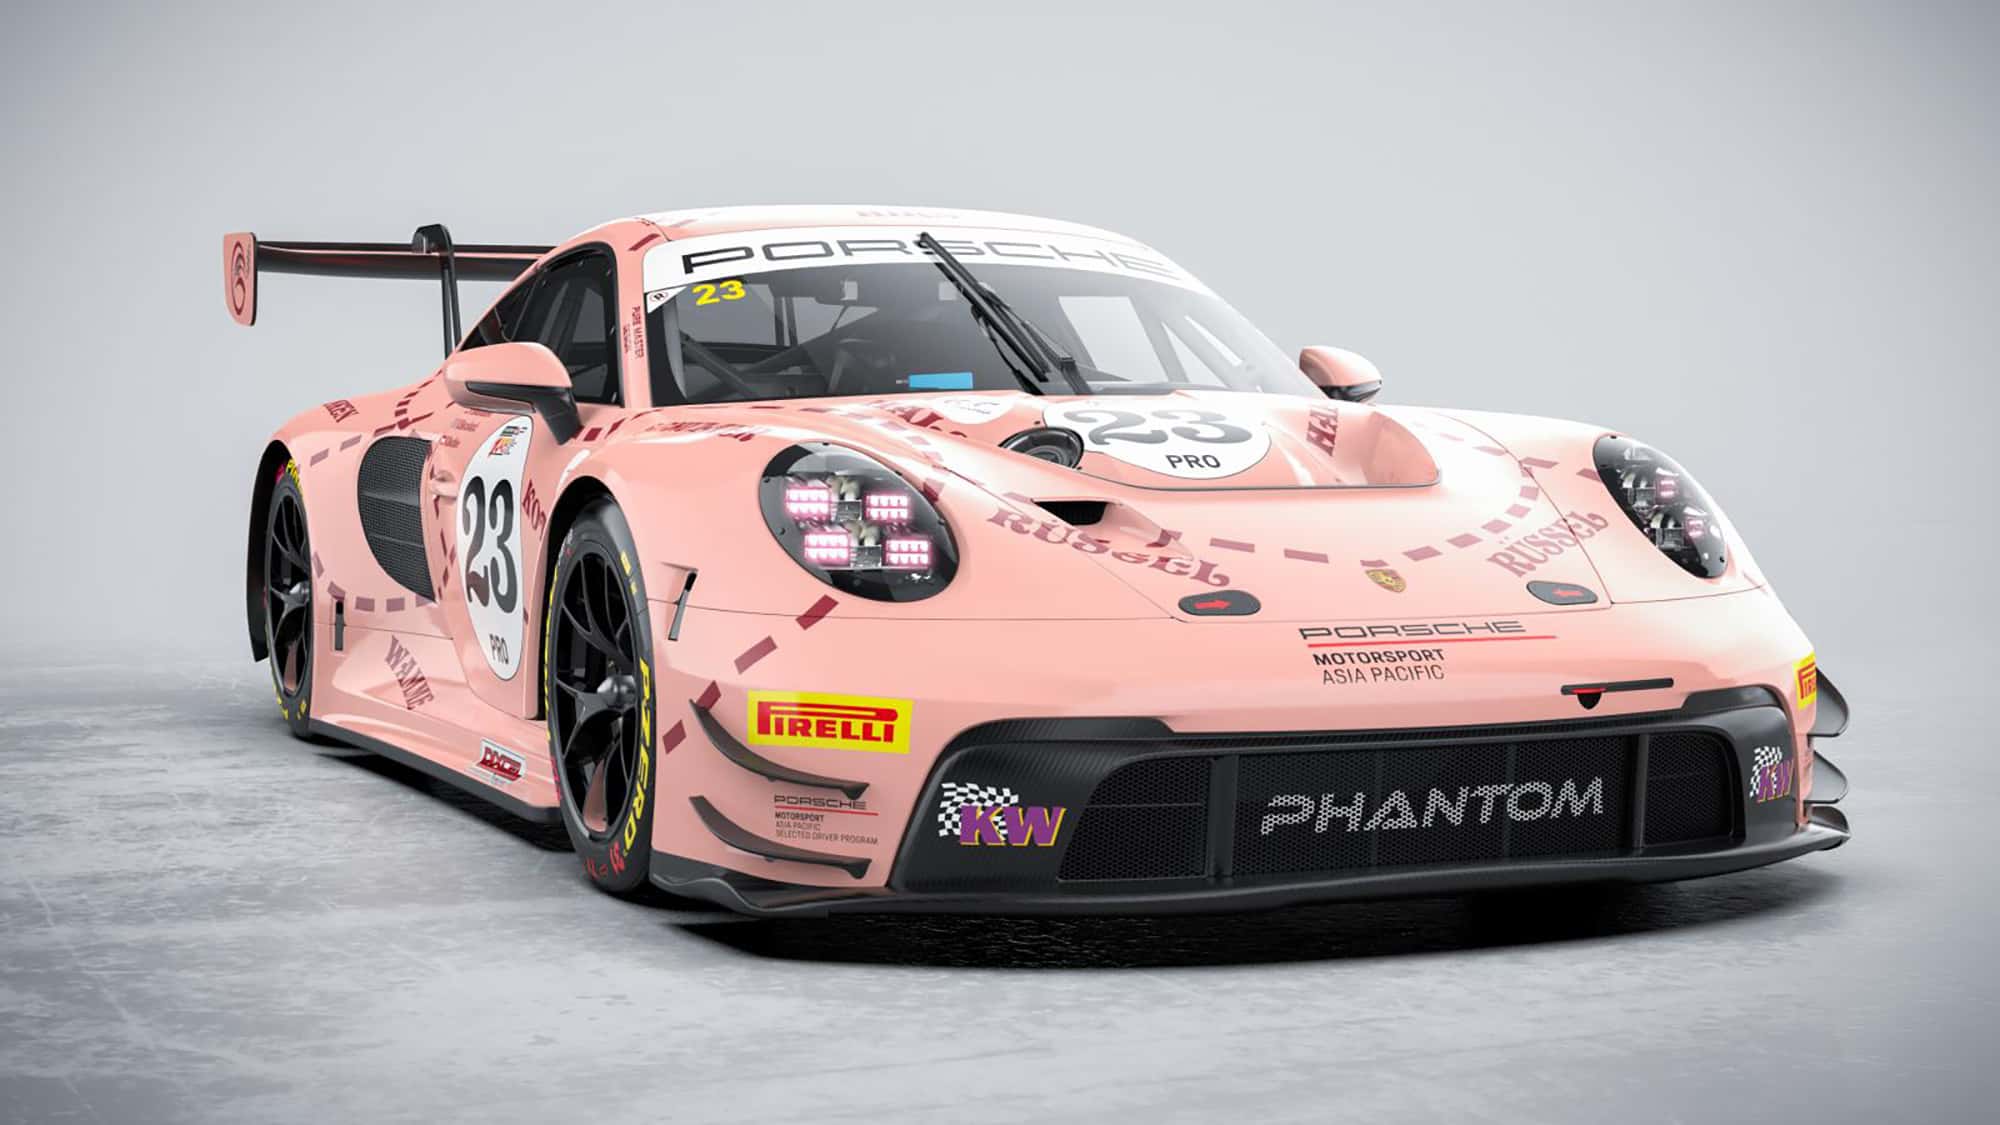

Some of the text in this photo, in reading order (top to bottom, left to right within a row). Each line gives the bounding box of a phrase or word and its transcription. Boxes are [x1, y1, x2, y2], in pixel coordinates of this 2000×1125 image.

[682, 239, 1180, 281] PORSCHE
[692, 280, 747, 306] 23
[1063, 409, 1253, 445] 23
[1166, 453, 1220, 469] PRO
[462, 475, 518, 614] 23
[1299, 620, 1526, 640] PORSCHE
[489, 633, 510, 665] PRO
[1313, 648, 1446, 666] MOTORSPORT
[1322, 664, 1445, 685] ASIA PACIFIC
[757, 701, 898, 743] PIRELLI
[1757, 760, 1794, 804] KW
[774, 795, 867, 810] PORSCHE
[1261, 776, 1603, 835] PHANTOM
[775, 811, 824, 823] MOTORSPORT
[775, 820, 821, 832] ASIA PACIFIC
[960, 805, 1067, 847] KW
[776, 829, 810, 840] SELECTED
[840, 833, 878, 845] PROGRAM
